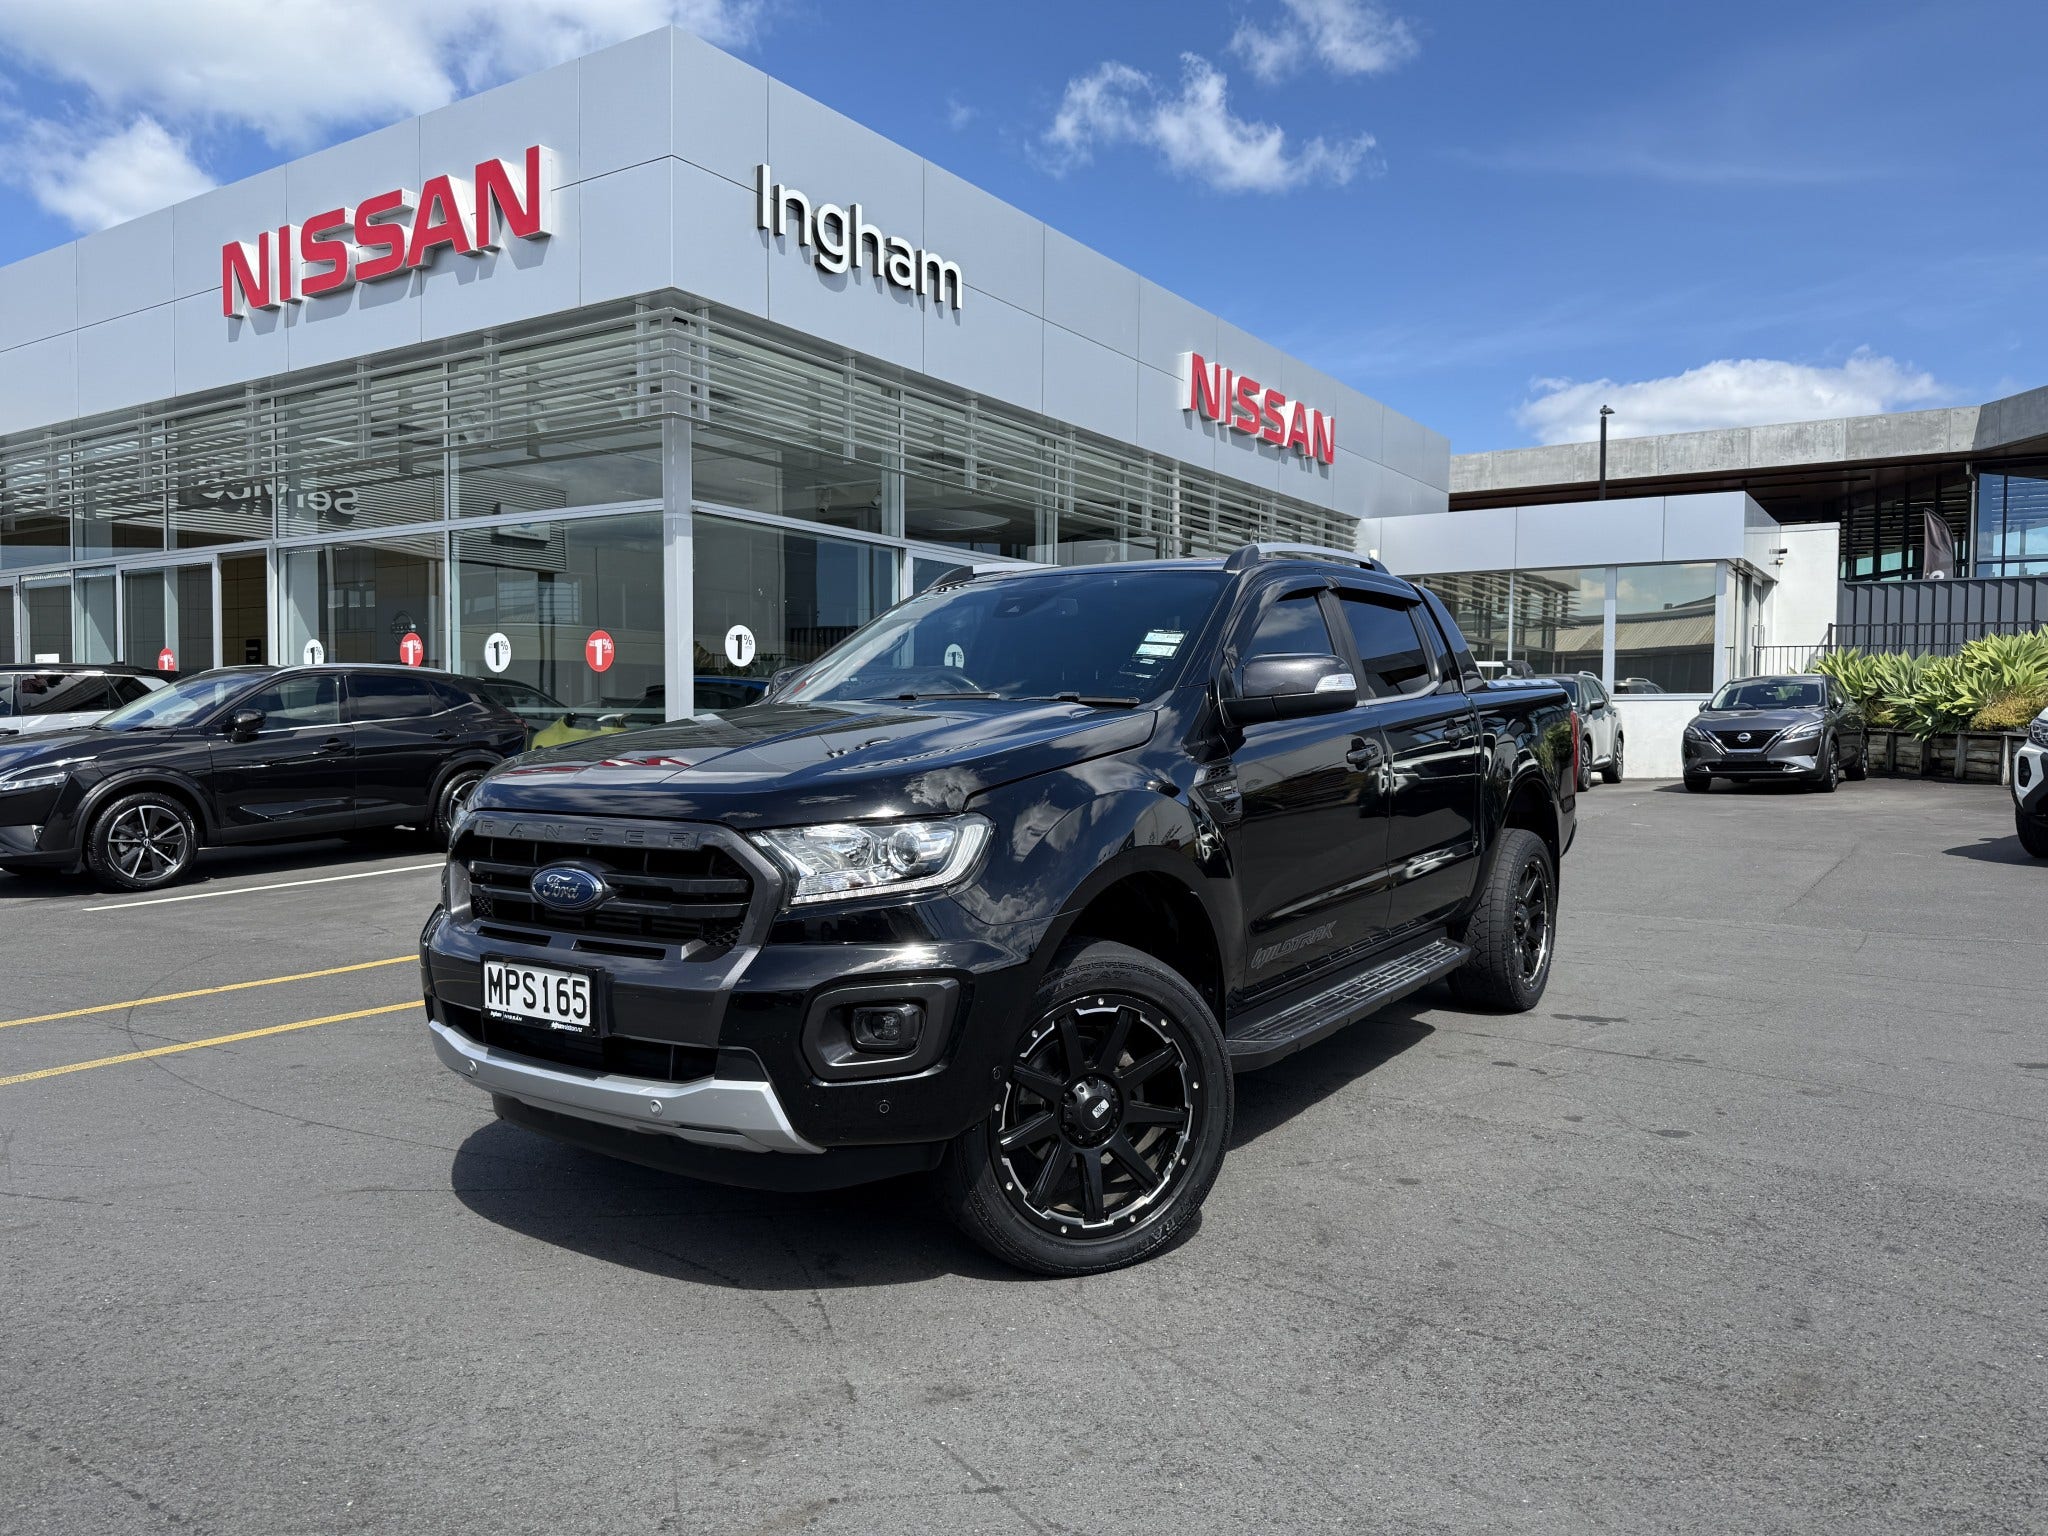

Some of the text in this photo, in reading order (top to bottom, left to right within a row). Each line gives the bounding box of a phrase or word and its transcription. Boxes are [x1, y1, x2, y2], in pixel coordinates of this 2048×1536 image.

[222, 144, 546, 319] NISSAN
[757, 163, 963, 310] Ingham
[1189, 351, 1336, 466] NISSAN
[479, 820, 692, 848] RANGER
[542, 873, 581, 900] Ford
[487, 966, 588, 1020] MPS165
